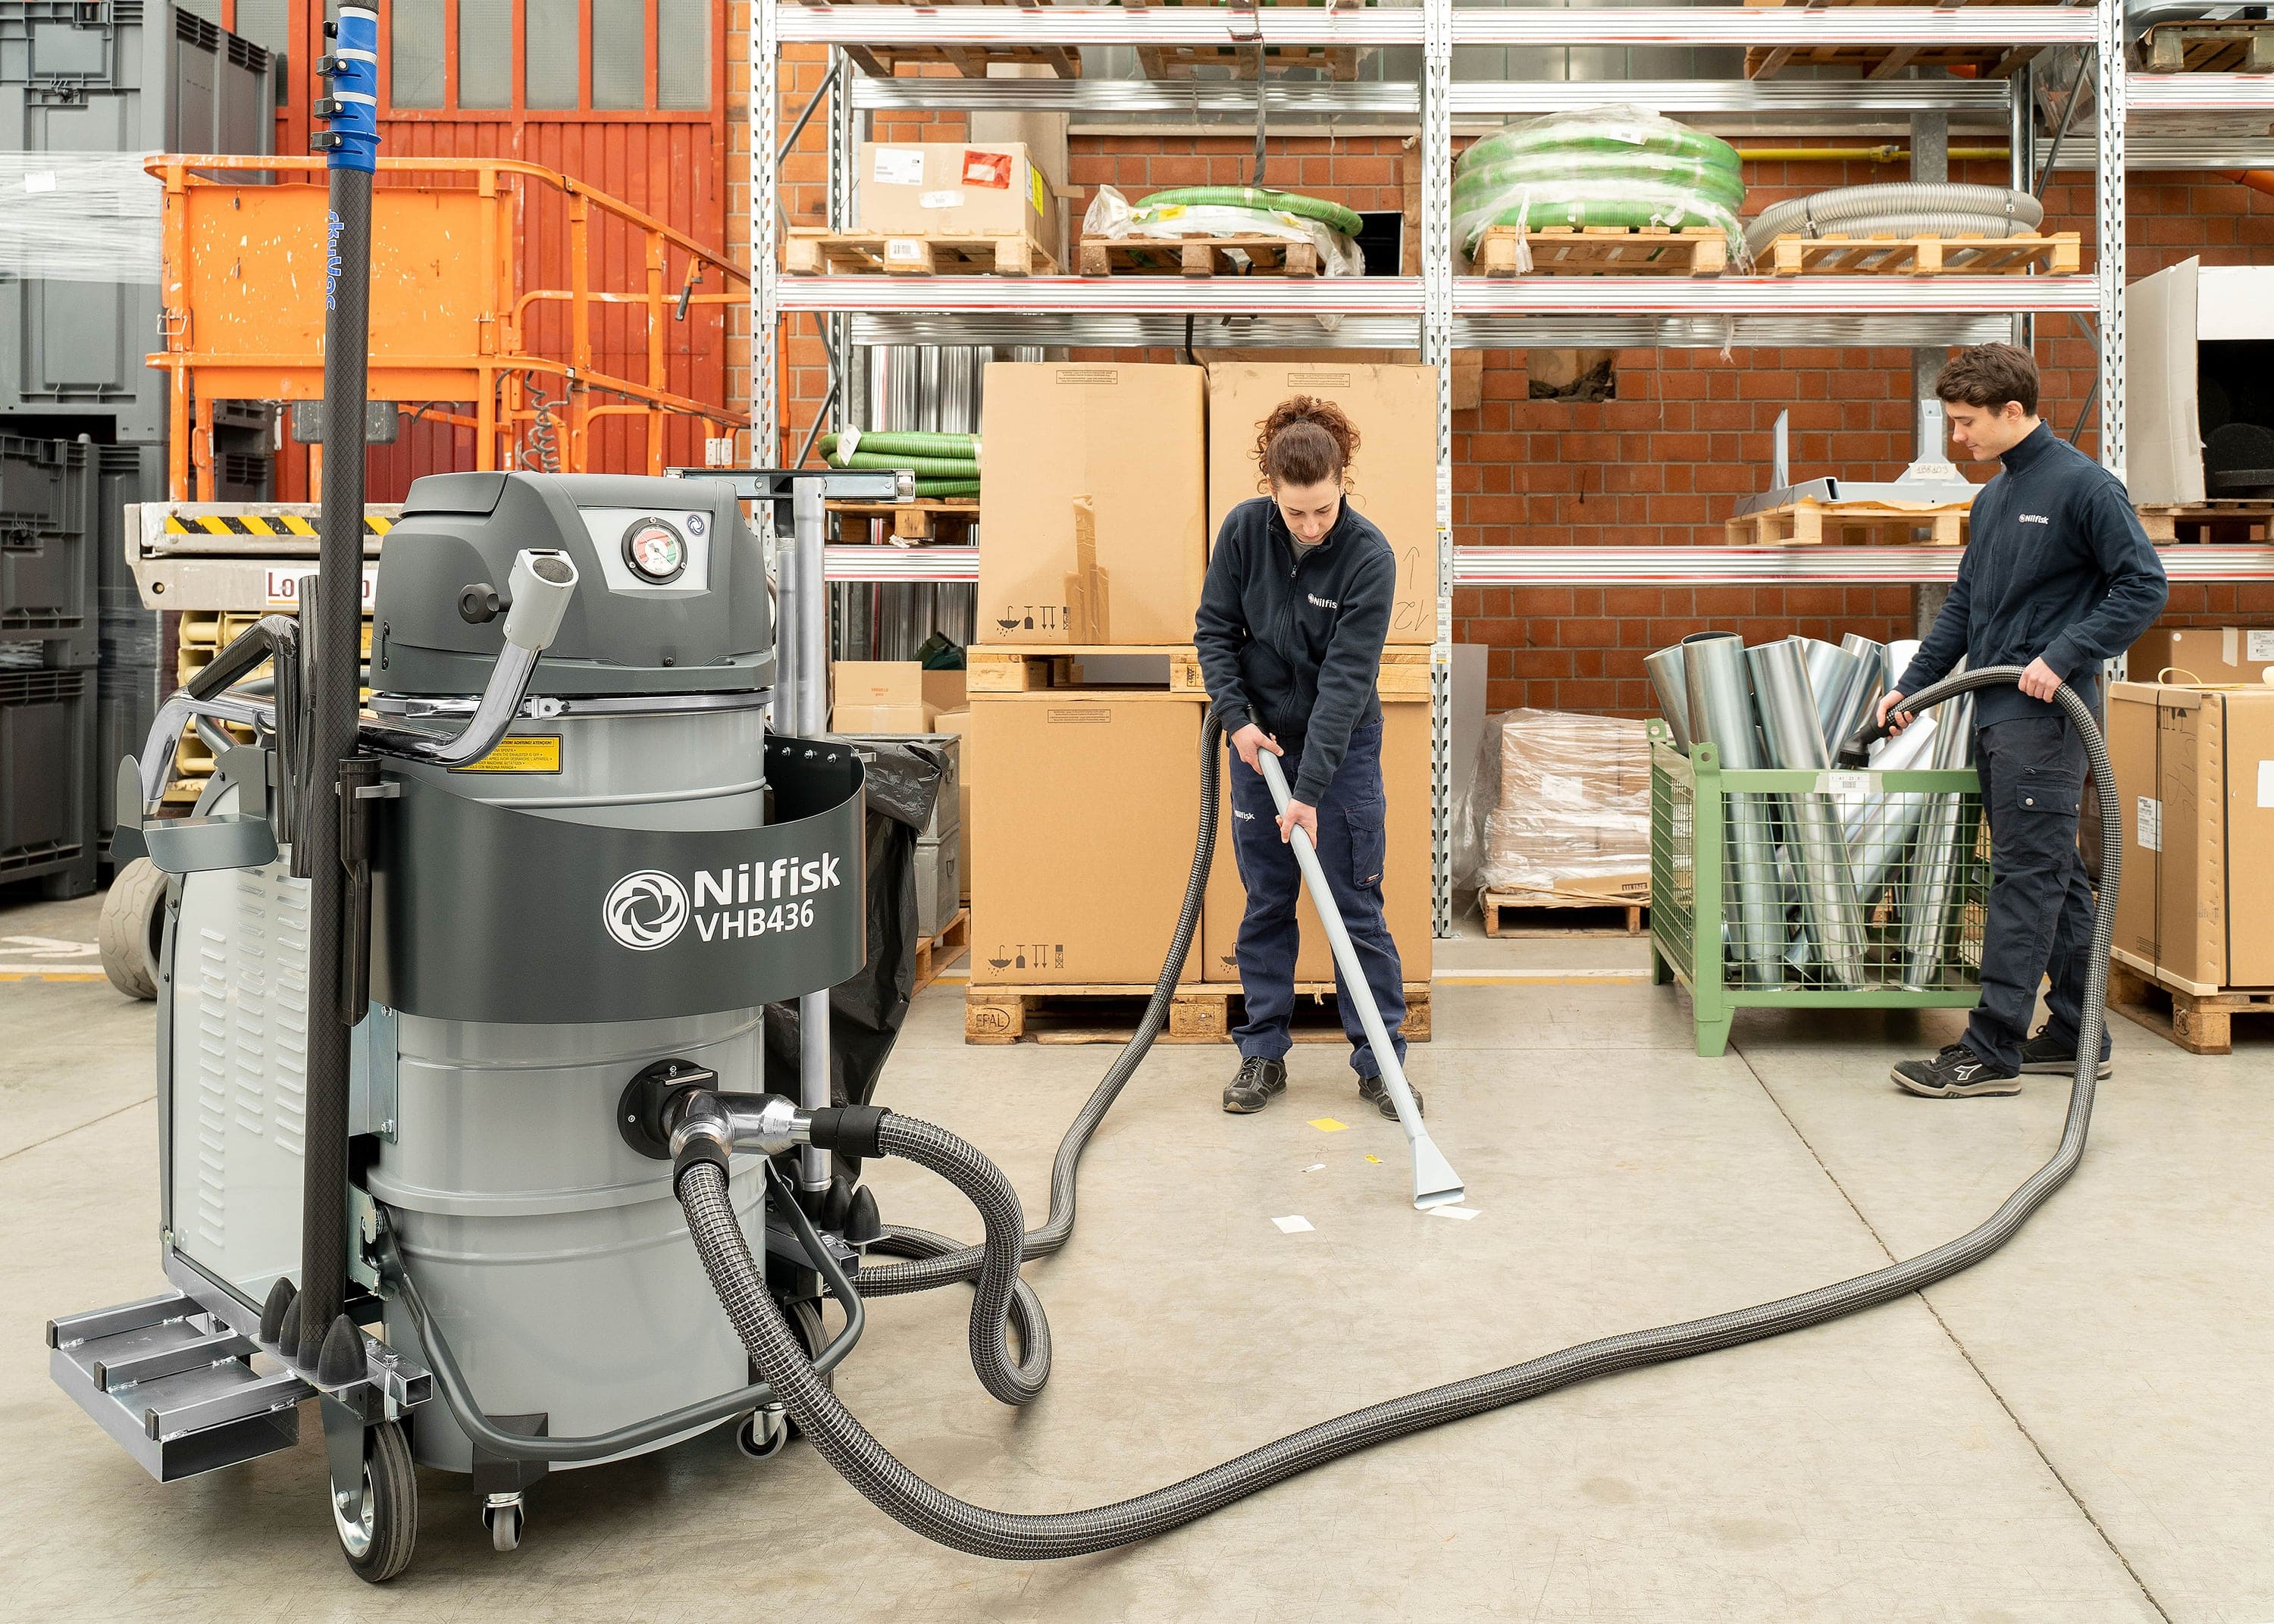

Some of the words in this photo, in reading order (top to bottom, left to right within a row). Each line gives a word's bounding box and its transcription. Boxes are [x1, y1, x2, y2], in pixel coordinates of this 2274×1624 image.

[2025, 515, 2049, 524] Nilfisk
[1314, 598, 1338, 609] Nilfis
[694, 852, 841, 908] Nilfisk
[694, 899, 814, 942] VHB436
[976, 1014, 1004, 1028] EPAL
